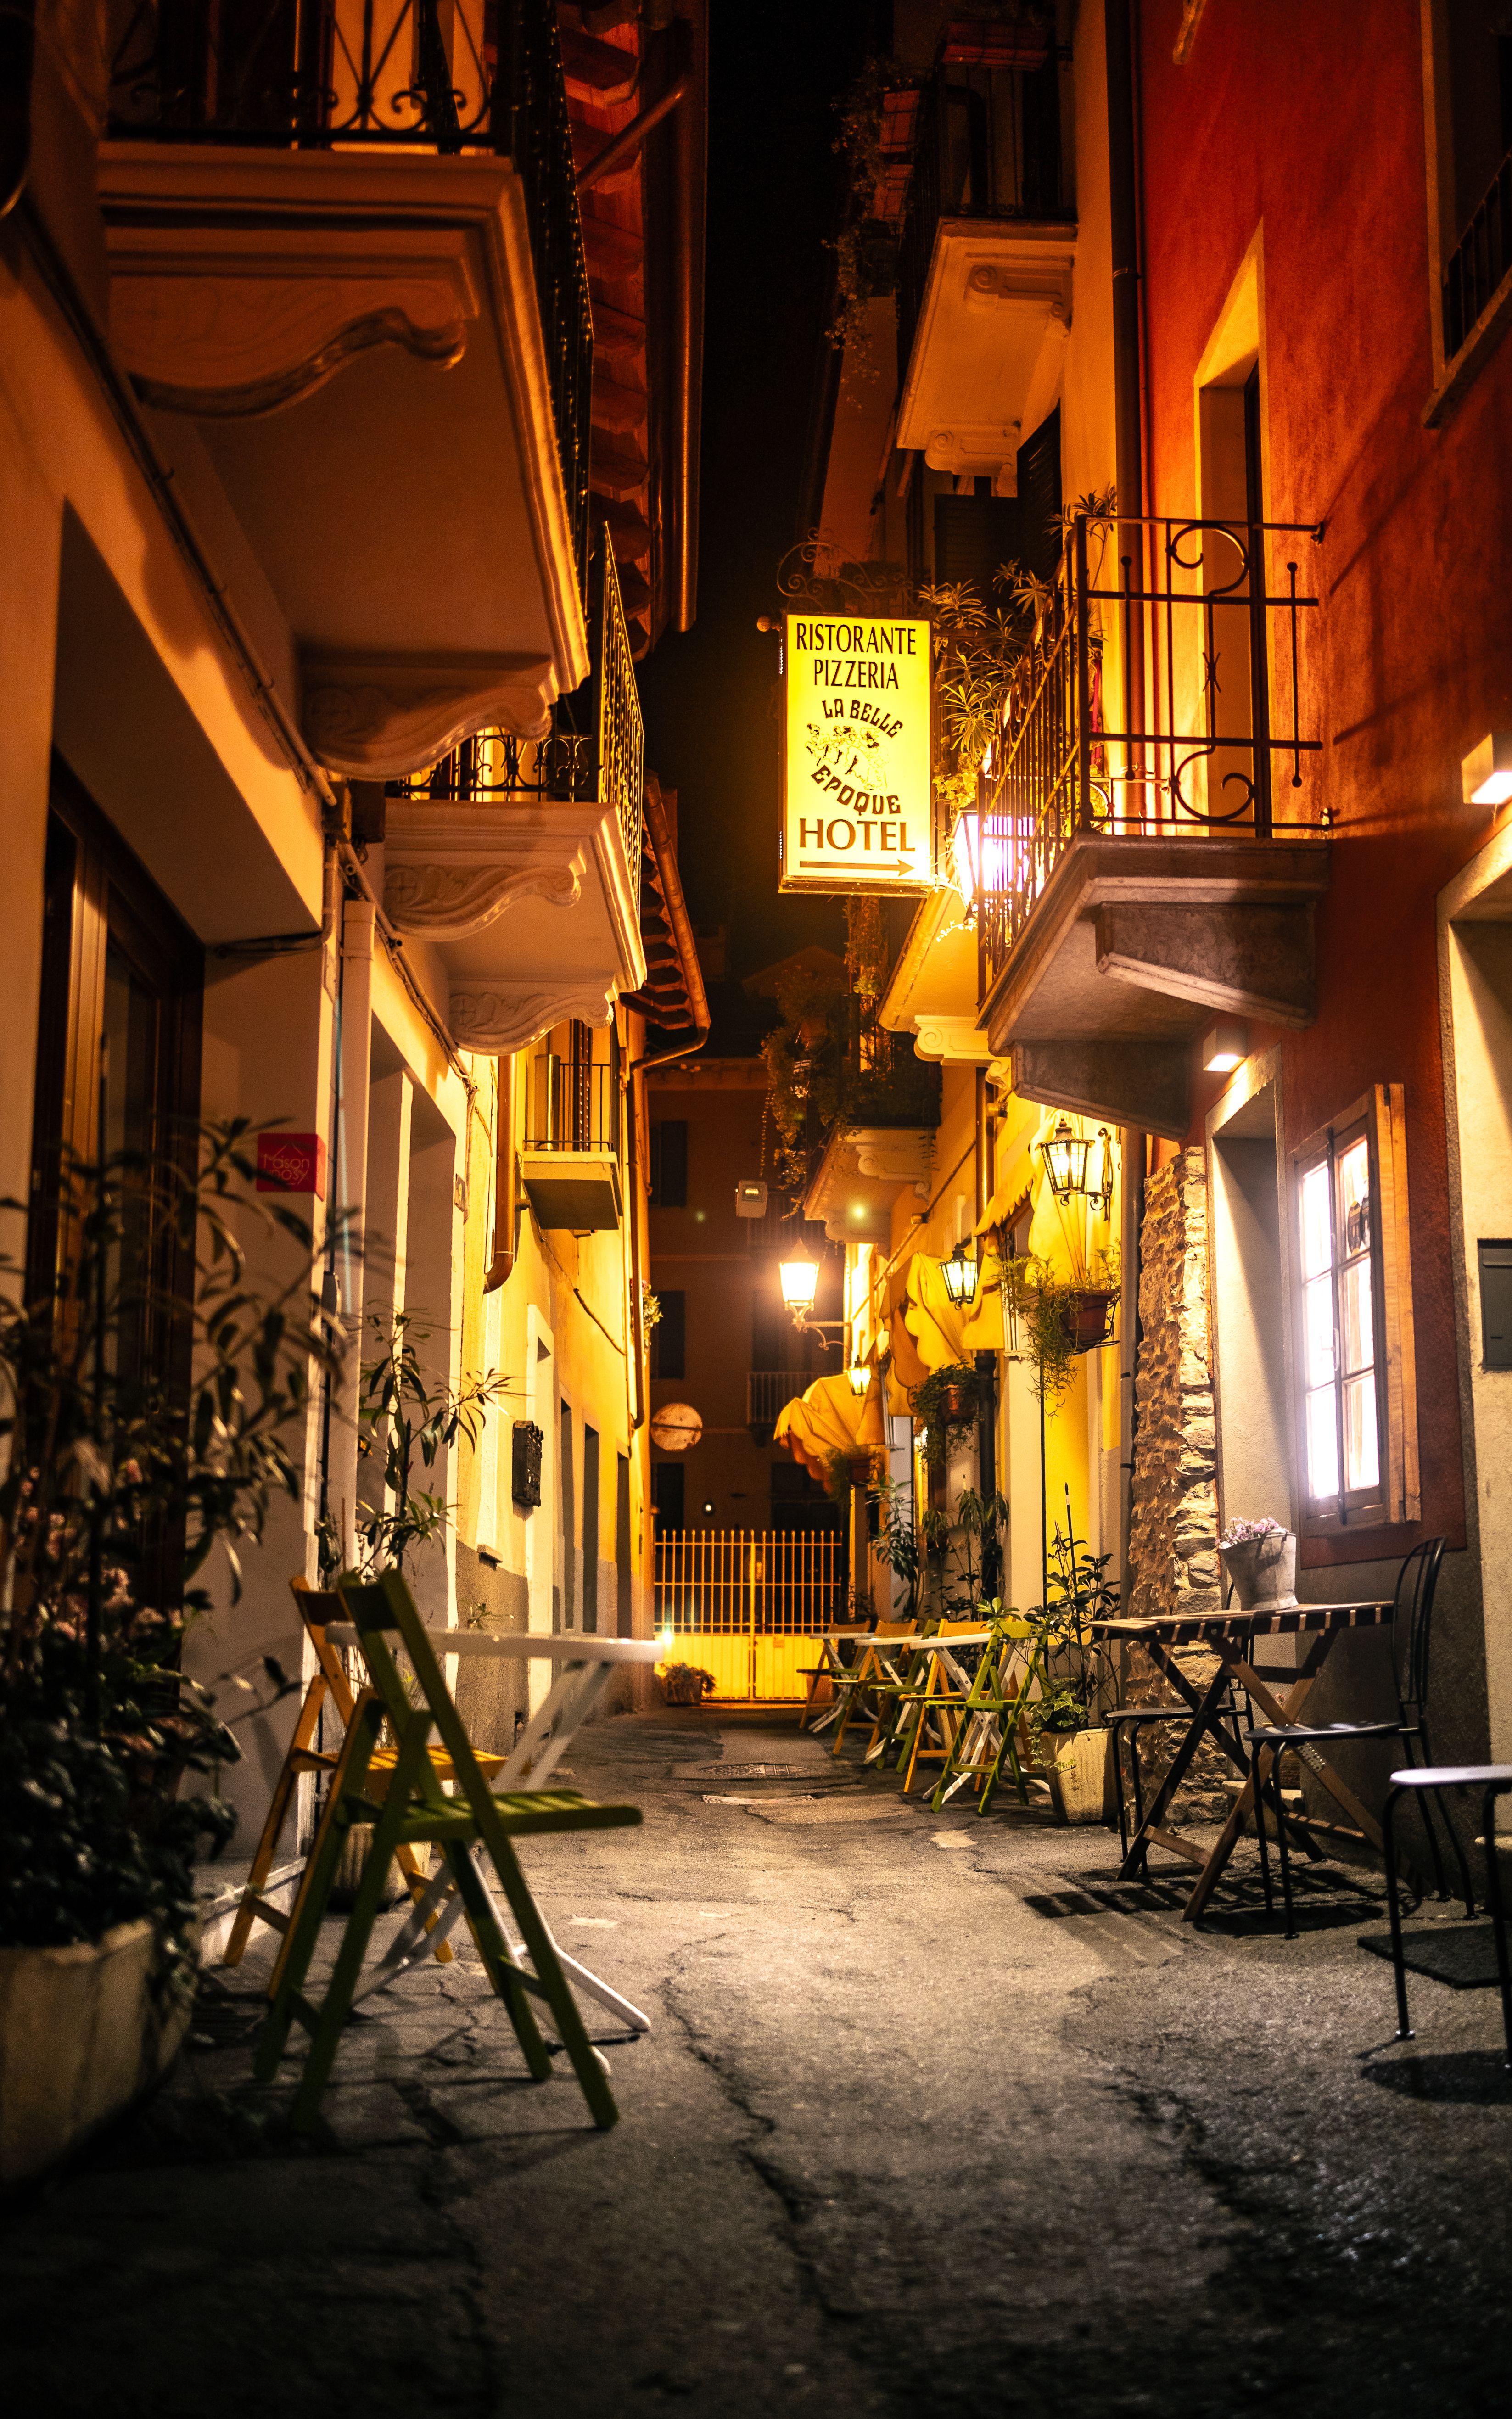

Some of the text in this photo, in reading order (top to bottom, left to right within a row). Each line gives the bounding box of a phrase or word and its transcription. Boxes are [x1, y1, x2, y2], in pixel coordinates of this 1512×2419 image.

[797, 623, 916, 655] RISTORANTE
[814, 659, 899, 689] PIZZERIA
[822, 699, 903, 738] LA BELLE
[811, 765, 901, 816] EPOQUE
[800, 818, 915, 851] HOTEL
